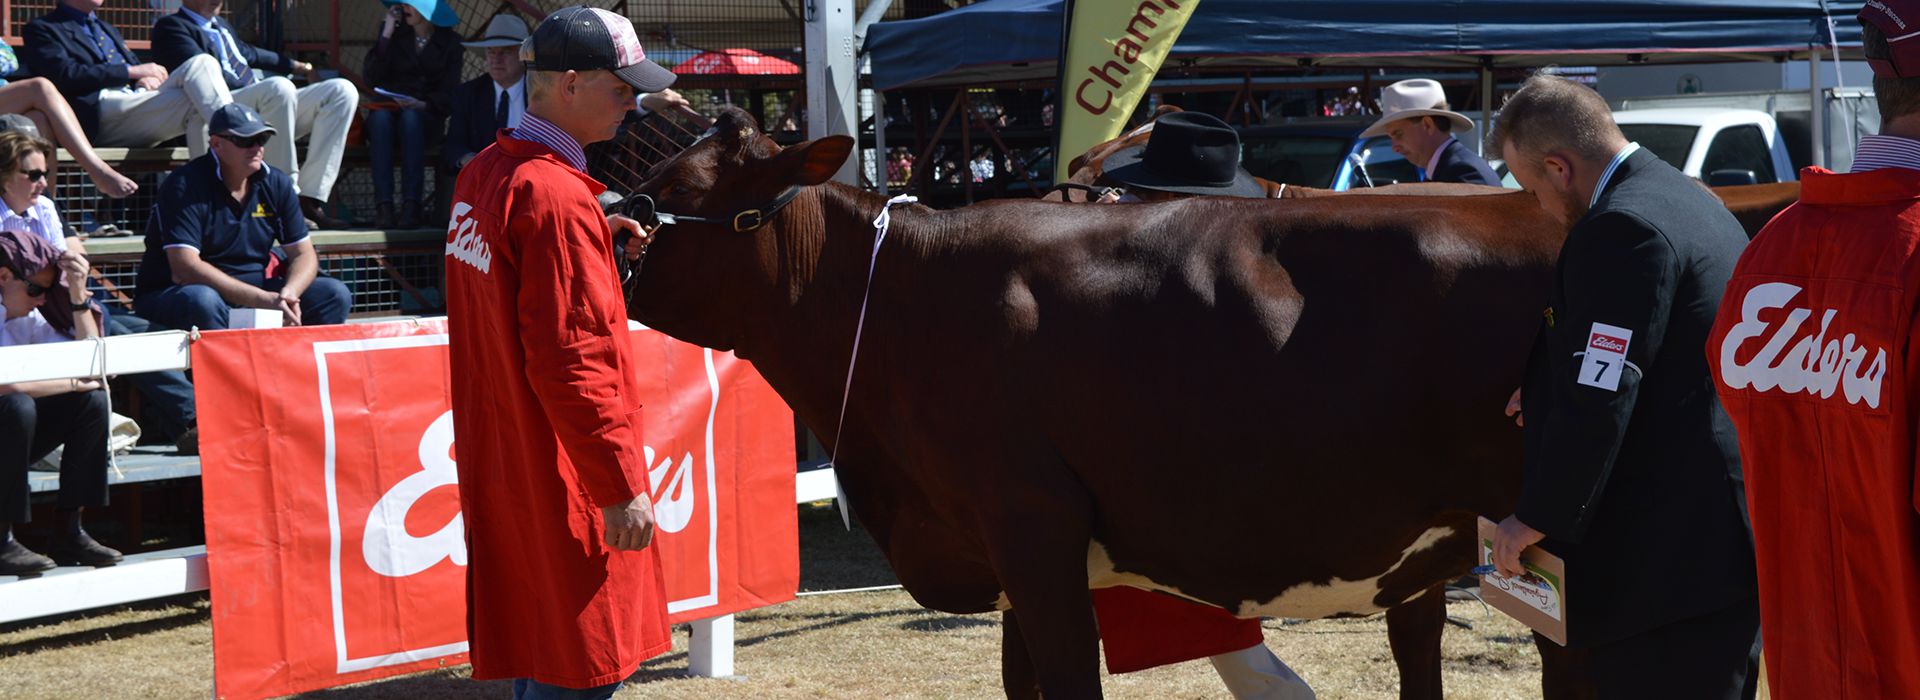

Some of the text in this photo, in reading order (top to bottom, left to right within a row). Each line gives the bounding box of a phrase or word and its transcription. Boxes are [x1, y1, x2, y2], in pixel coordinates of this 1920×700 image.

[1592, 336, 1625, 351] Elders
[1720, 282, 1887, 409] Elders
[1594, 360, 1610, 383] 7
